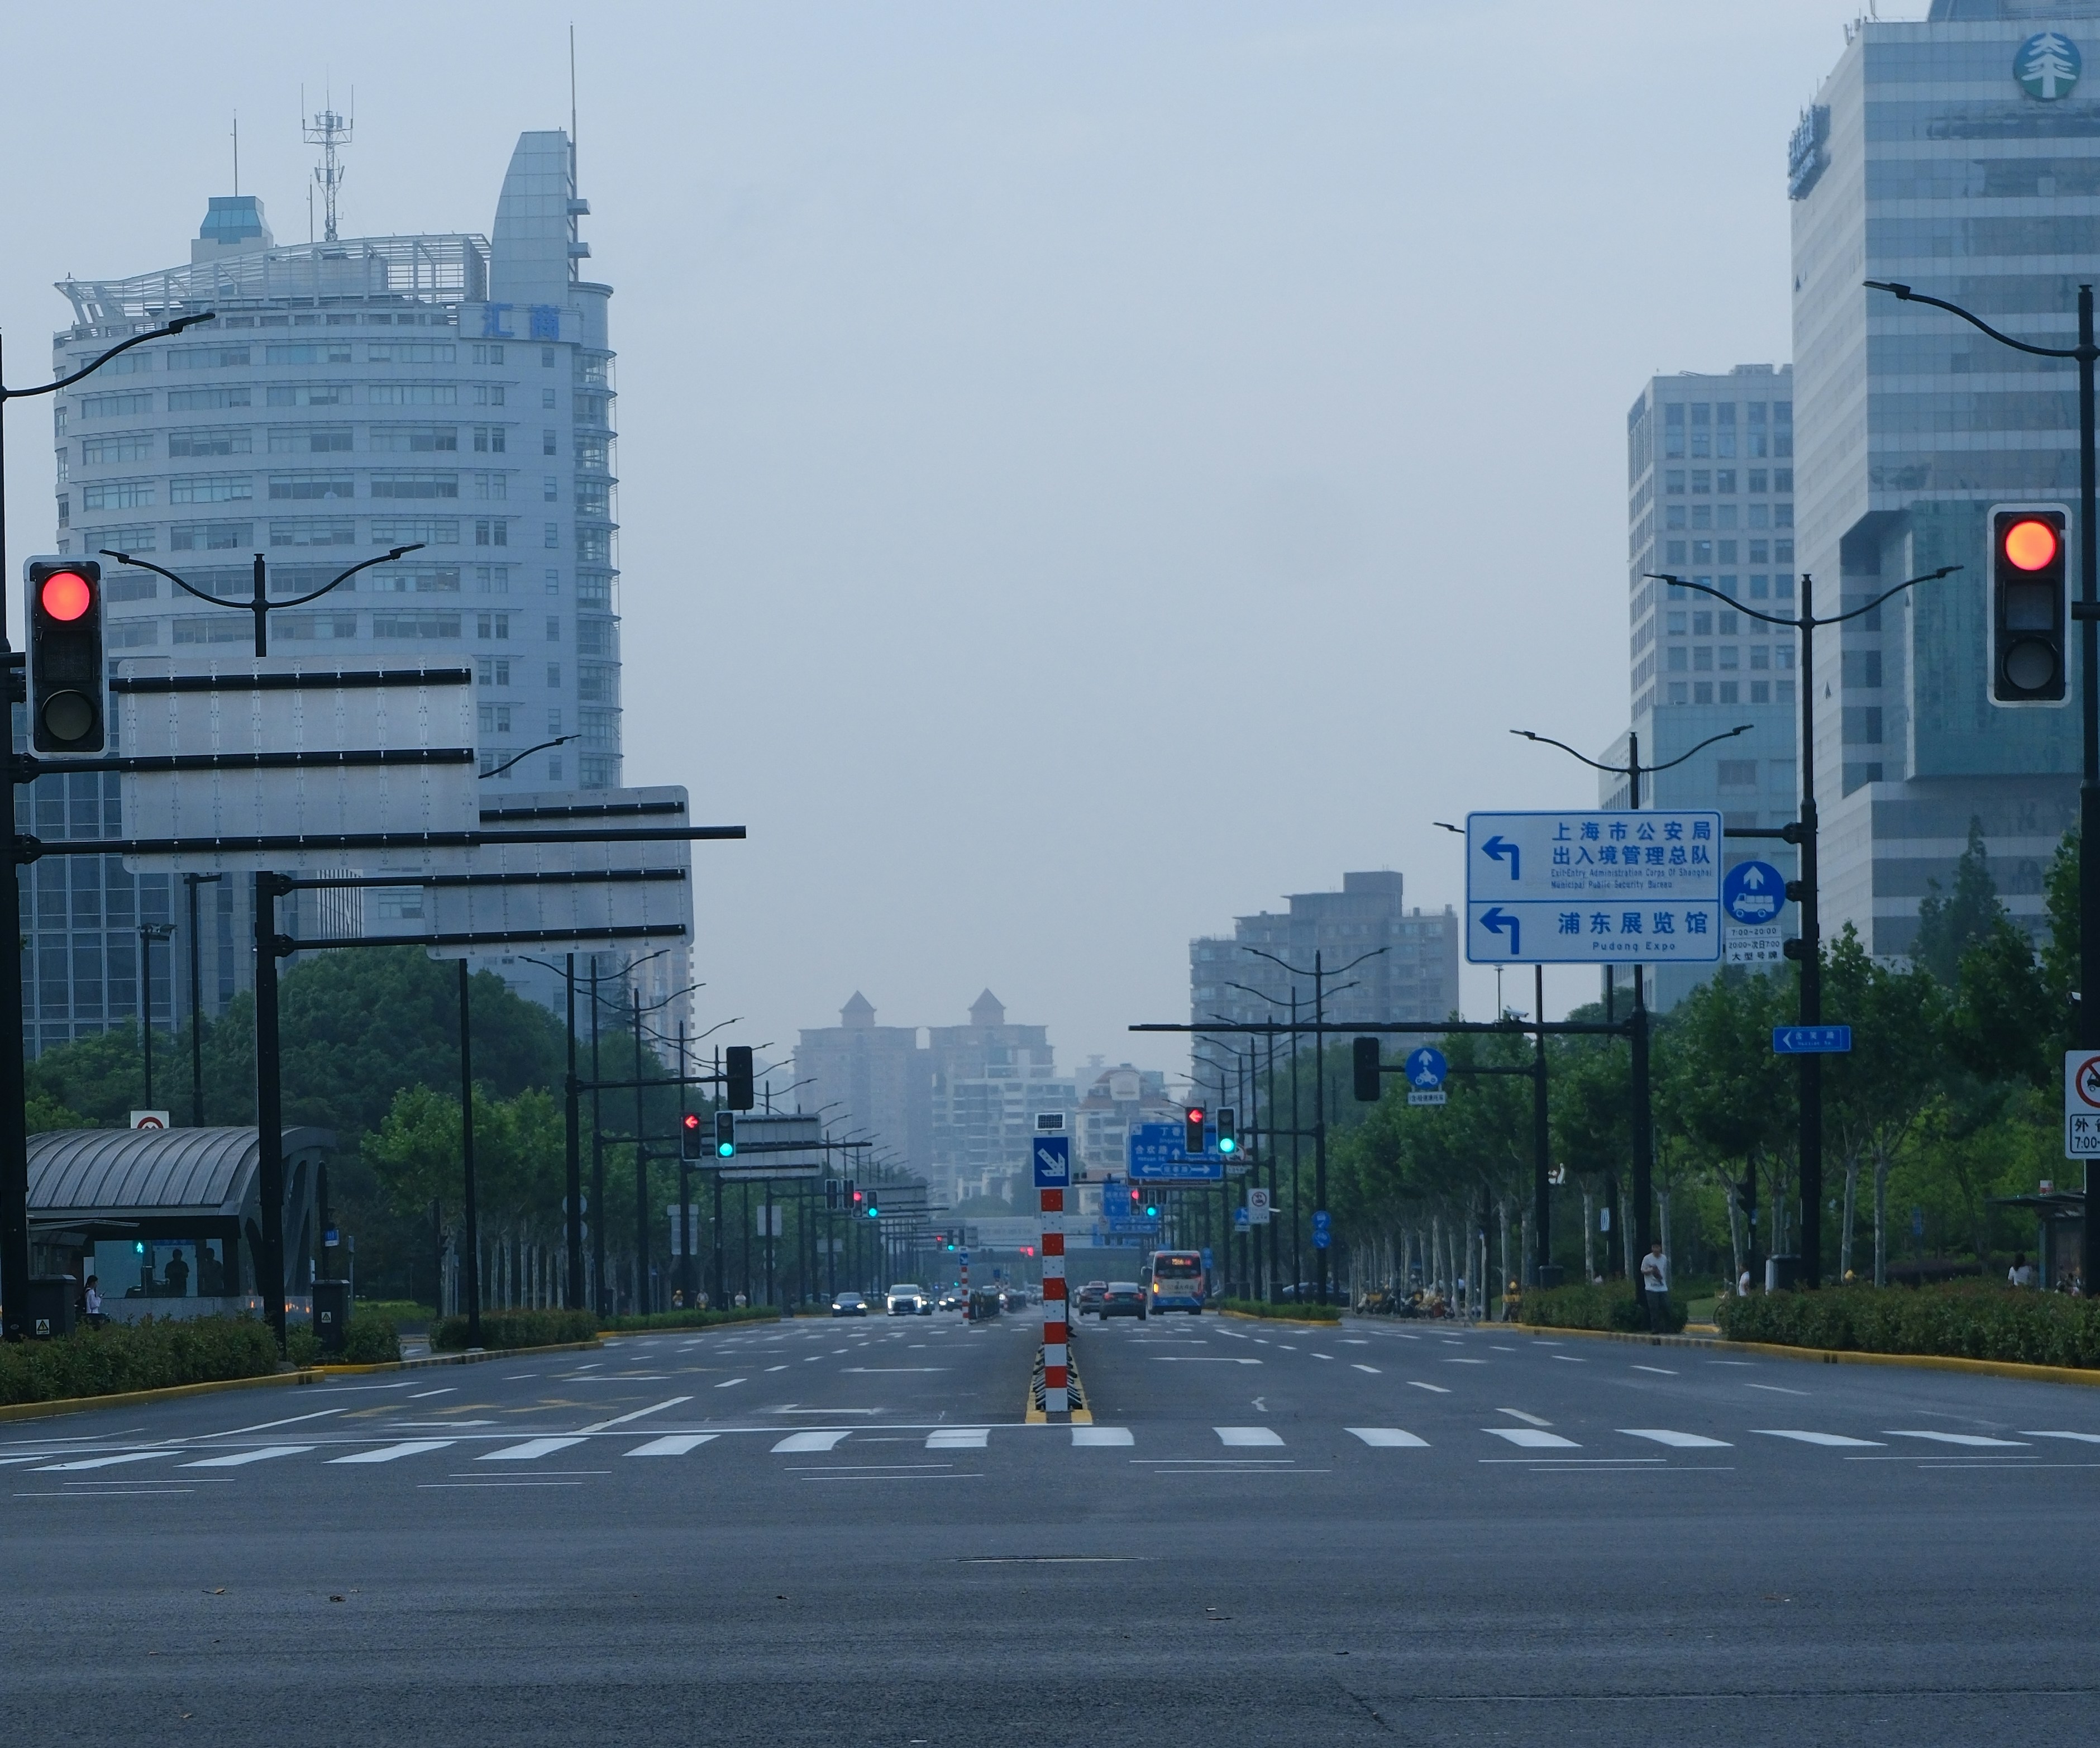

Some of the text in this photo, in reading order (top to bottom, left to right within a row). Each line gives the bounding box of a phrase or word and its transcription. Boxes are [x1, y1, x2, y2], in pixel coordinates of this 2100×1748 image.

[1552, 821, 1711, 841] 上海市公安局
[1553, 845, 1710, 865] 出入境管理总队
[1590, 868, 1642, 878] Administration
[1645, 869, 1665, 878] Corps
[1678, 868, 1711, 878] Shanghai
[1551, 880, 1672, 890] Municipal Public Security Bureau
[1558, 912, 1708, 935] 浦东展览馆
[1592, 941, 1676, 952] Pudong Expo
[1732, 951, 1778, 961] 大型号牌
